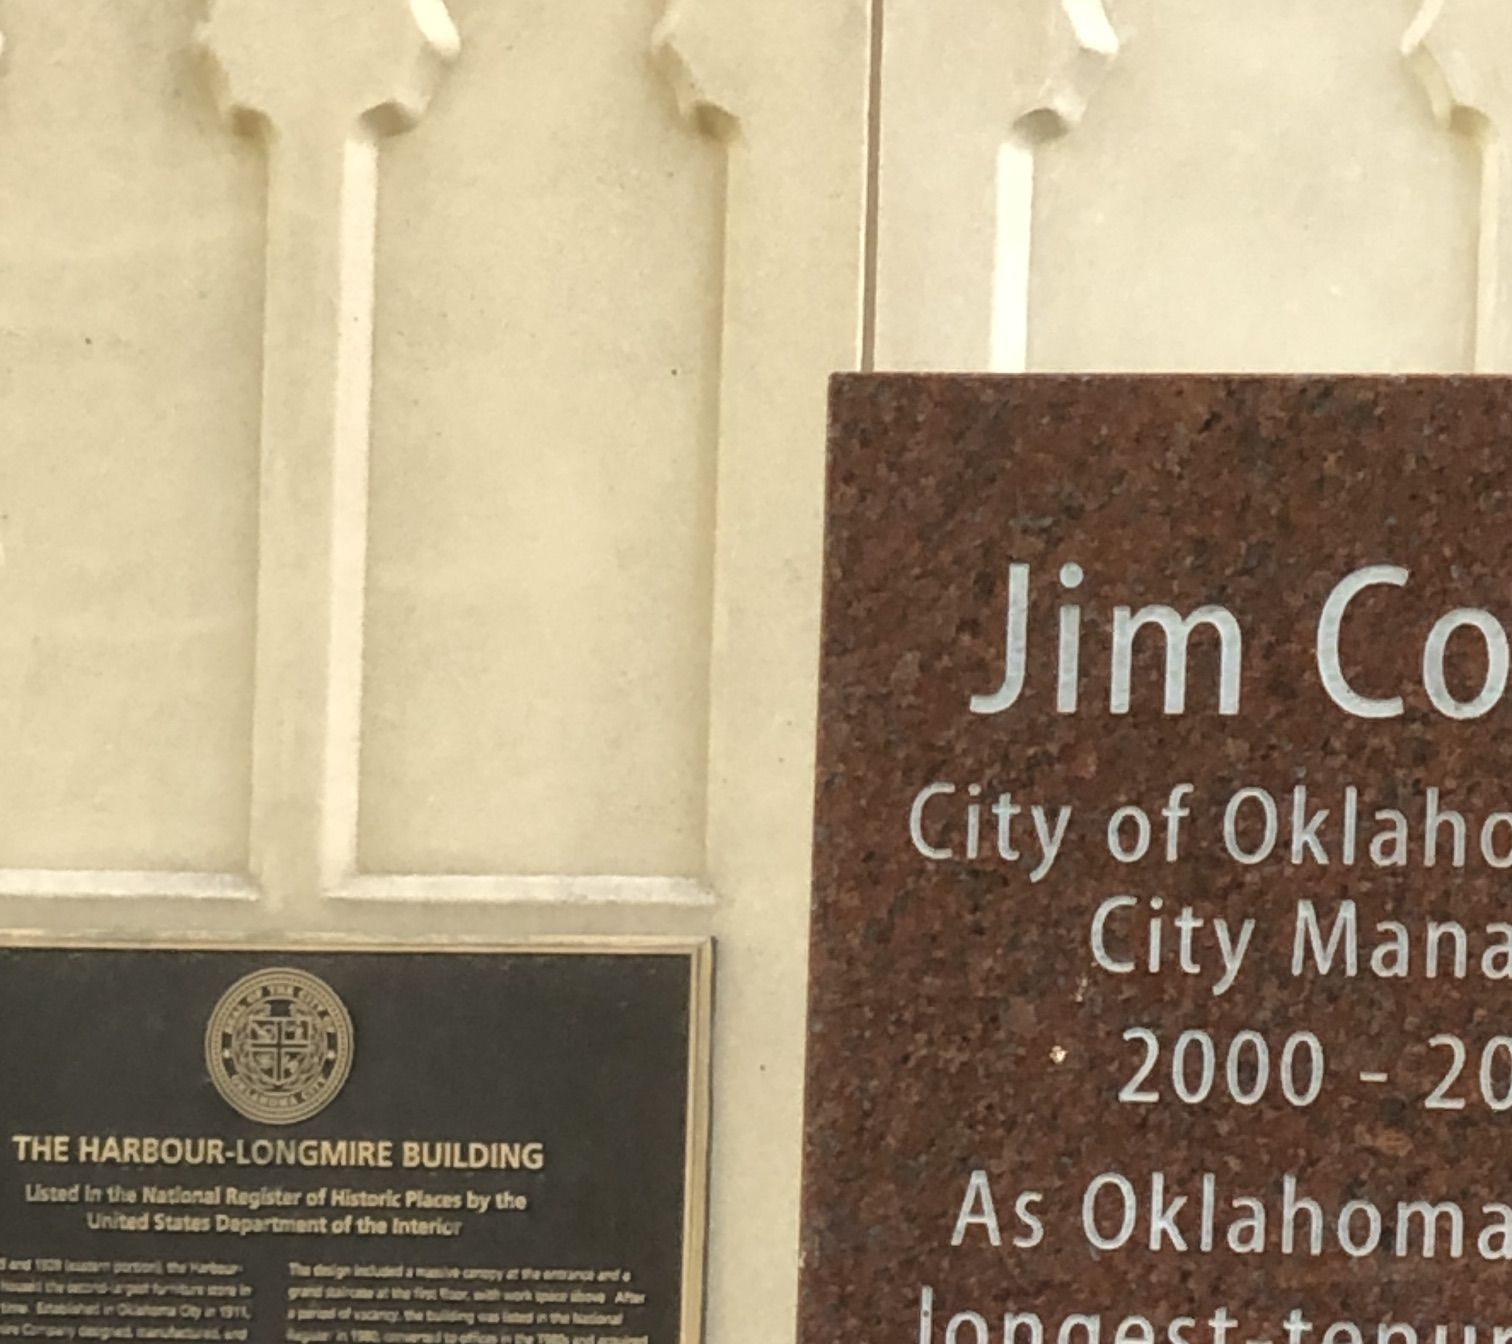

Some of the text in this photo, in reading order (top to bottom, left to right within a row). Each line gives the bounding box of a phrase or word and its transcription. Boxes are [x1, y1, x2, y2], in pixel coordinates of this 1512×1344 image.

[969, 563, 1242, 716] Jim
[909, 783, 1071, 882] City
[1107, 784, 1193, 863] of
[1090, 895, 1254, 995] City
[1119, 1027, 1324, 1106] 2000
[12, 1135, 544, 1170] THE HARBOUR-LONGMIRE BUILDING
[25, 1183, 80, 1202] Listed
[107, 1185, 137, 1203] the
[142, 1186, 221, 1205] National
[226, 1187, 300, 1210] Register
[306, 1187, 327, 1207] of
[331, 1189, 402, 1208] Historic
[405, 1190, 462, 1209] Places
[467, 1191, 491, 1213] by
[496, 1191, 528, 1210] the
[87, 1211, 463, 1236] United States Department of the Interior
[951, 1170, 1044, 1249] As
